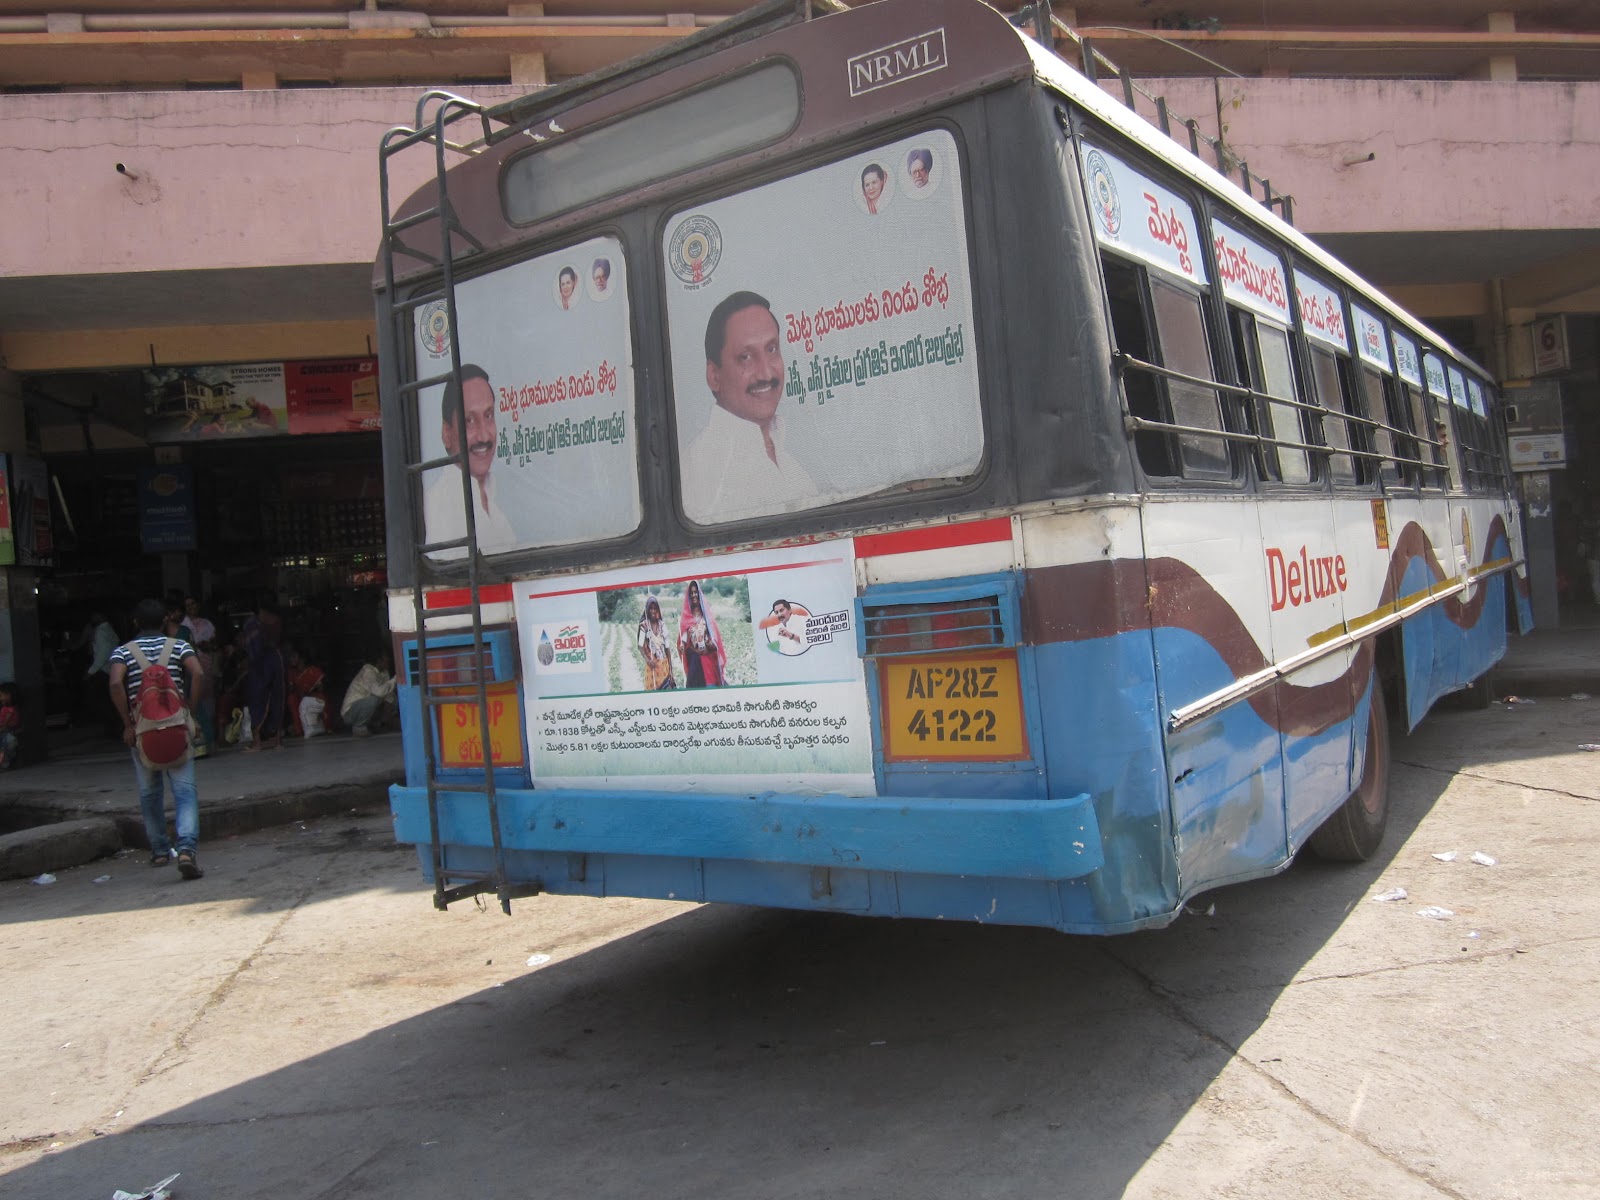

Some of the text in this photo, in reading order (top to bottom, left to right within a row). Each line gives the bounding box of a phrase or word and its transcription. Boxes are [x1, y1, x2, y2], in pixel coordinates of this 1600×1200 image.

[854, 40, 940, 88] NRML
[1143, 192, 1193, 275] మెట్ట
[786, 267, 949, 353] మెట్ట భూములకు నిండు శోభ
[1541, 323, 1555, 351] 6
[824, 355, 852, 399] రైతుల
[853, 340, 889, 387] ప్రగతికి
[890, 334, 924, 373] ఇందిర
[924, 323, 964, 366] జలప్రభ
[499, 360, 616, 422] మెట్ట భూములకు నిండు శోభ
[524, 426, 545, 463] రైతుల
[572, 416, 597, 446] ఇందిర
[597, 410, 625, 445] జలప్రభ
[1265, 544, 1347, 611] Deluxe
[554, 634, 586, 650] ఇందిర
[806, 632, 831, 644] కాలం
[555, 648, 587, 664] జలప్రభ
[906, 667, 999, 699] AP28Z
[542, 710, 556, 724] వచ్చే
[648, 707, 660, 717] 10
[662, 706, 680, 718] లక్షల
[681, 704, 710, 715] ఎకరాల
[712, 701, 742, 715] భూమికి
[743, 699, 781, 712] సాగునీటి
[544, 727, 580, 737] రూ.1838
[658, 721, 685, 732] చెందిన
[749, 717, 786, 729] సాగునీటి
[788, 717, 820, 728] వనరుల
[822, 716, 847, 730] కల్పన
[907, 709, 997, 742] 4122
[546, 742, 569, 754] మొత్తం
[570, 742, 589, 751] 5.81
[591, 742, 608, 753] లక్షల
[703, 736, 736, 747] ఎగువకు
[821, 735, 850, 746] పథకం
